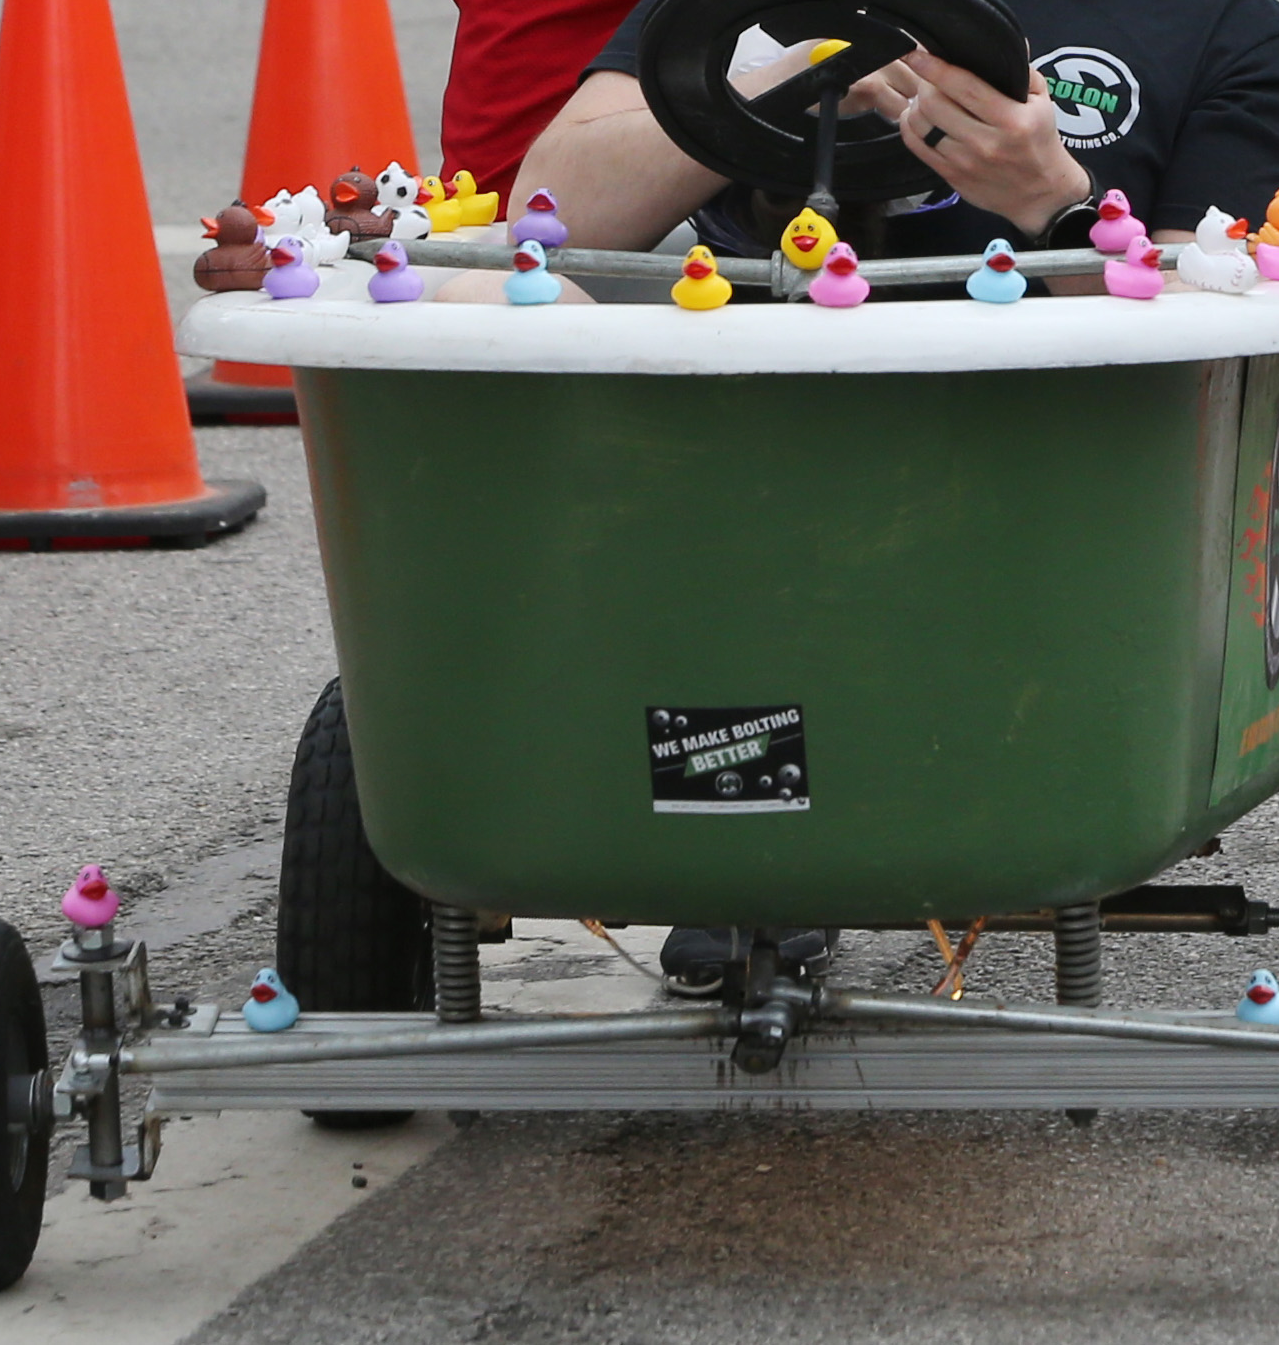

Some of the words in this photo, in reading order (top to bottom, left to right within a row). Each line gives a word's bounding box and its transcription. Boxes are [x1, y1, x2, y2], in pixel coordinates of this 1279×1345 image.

[1045, 77, 1119, 114] SOLON
[1101, 131, 1121, 146] CO.
[652, 740, 680, 759] WE
[681, 728, 730, 752] MAKE
[731, 708, 800, 740] BOLTING
[690, 740, 763, 773] BETTER
